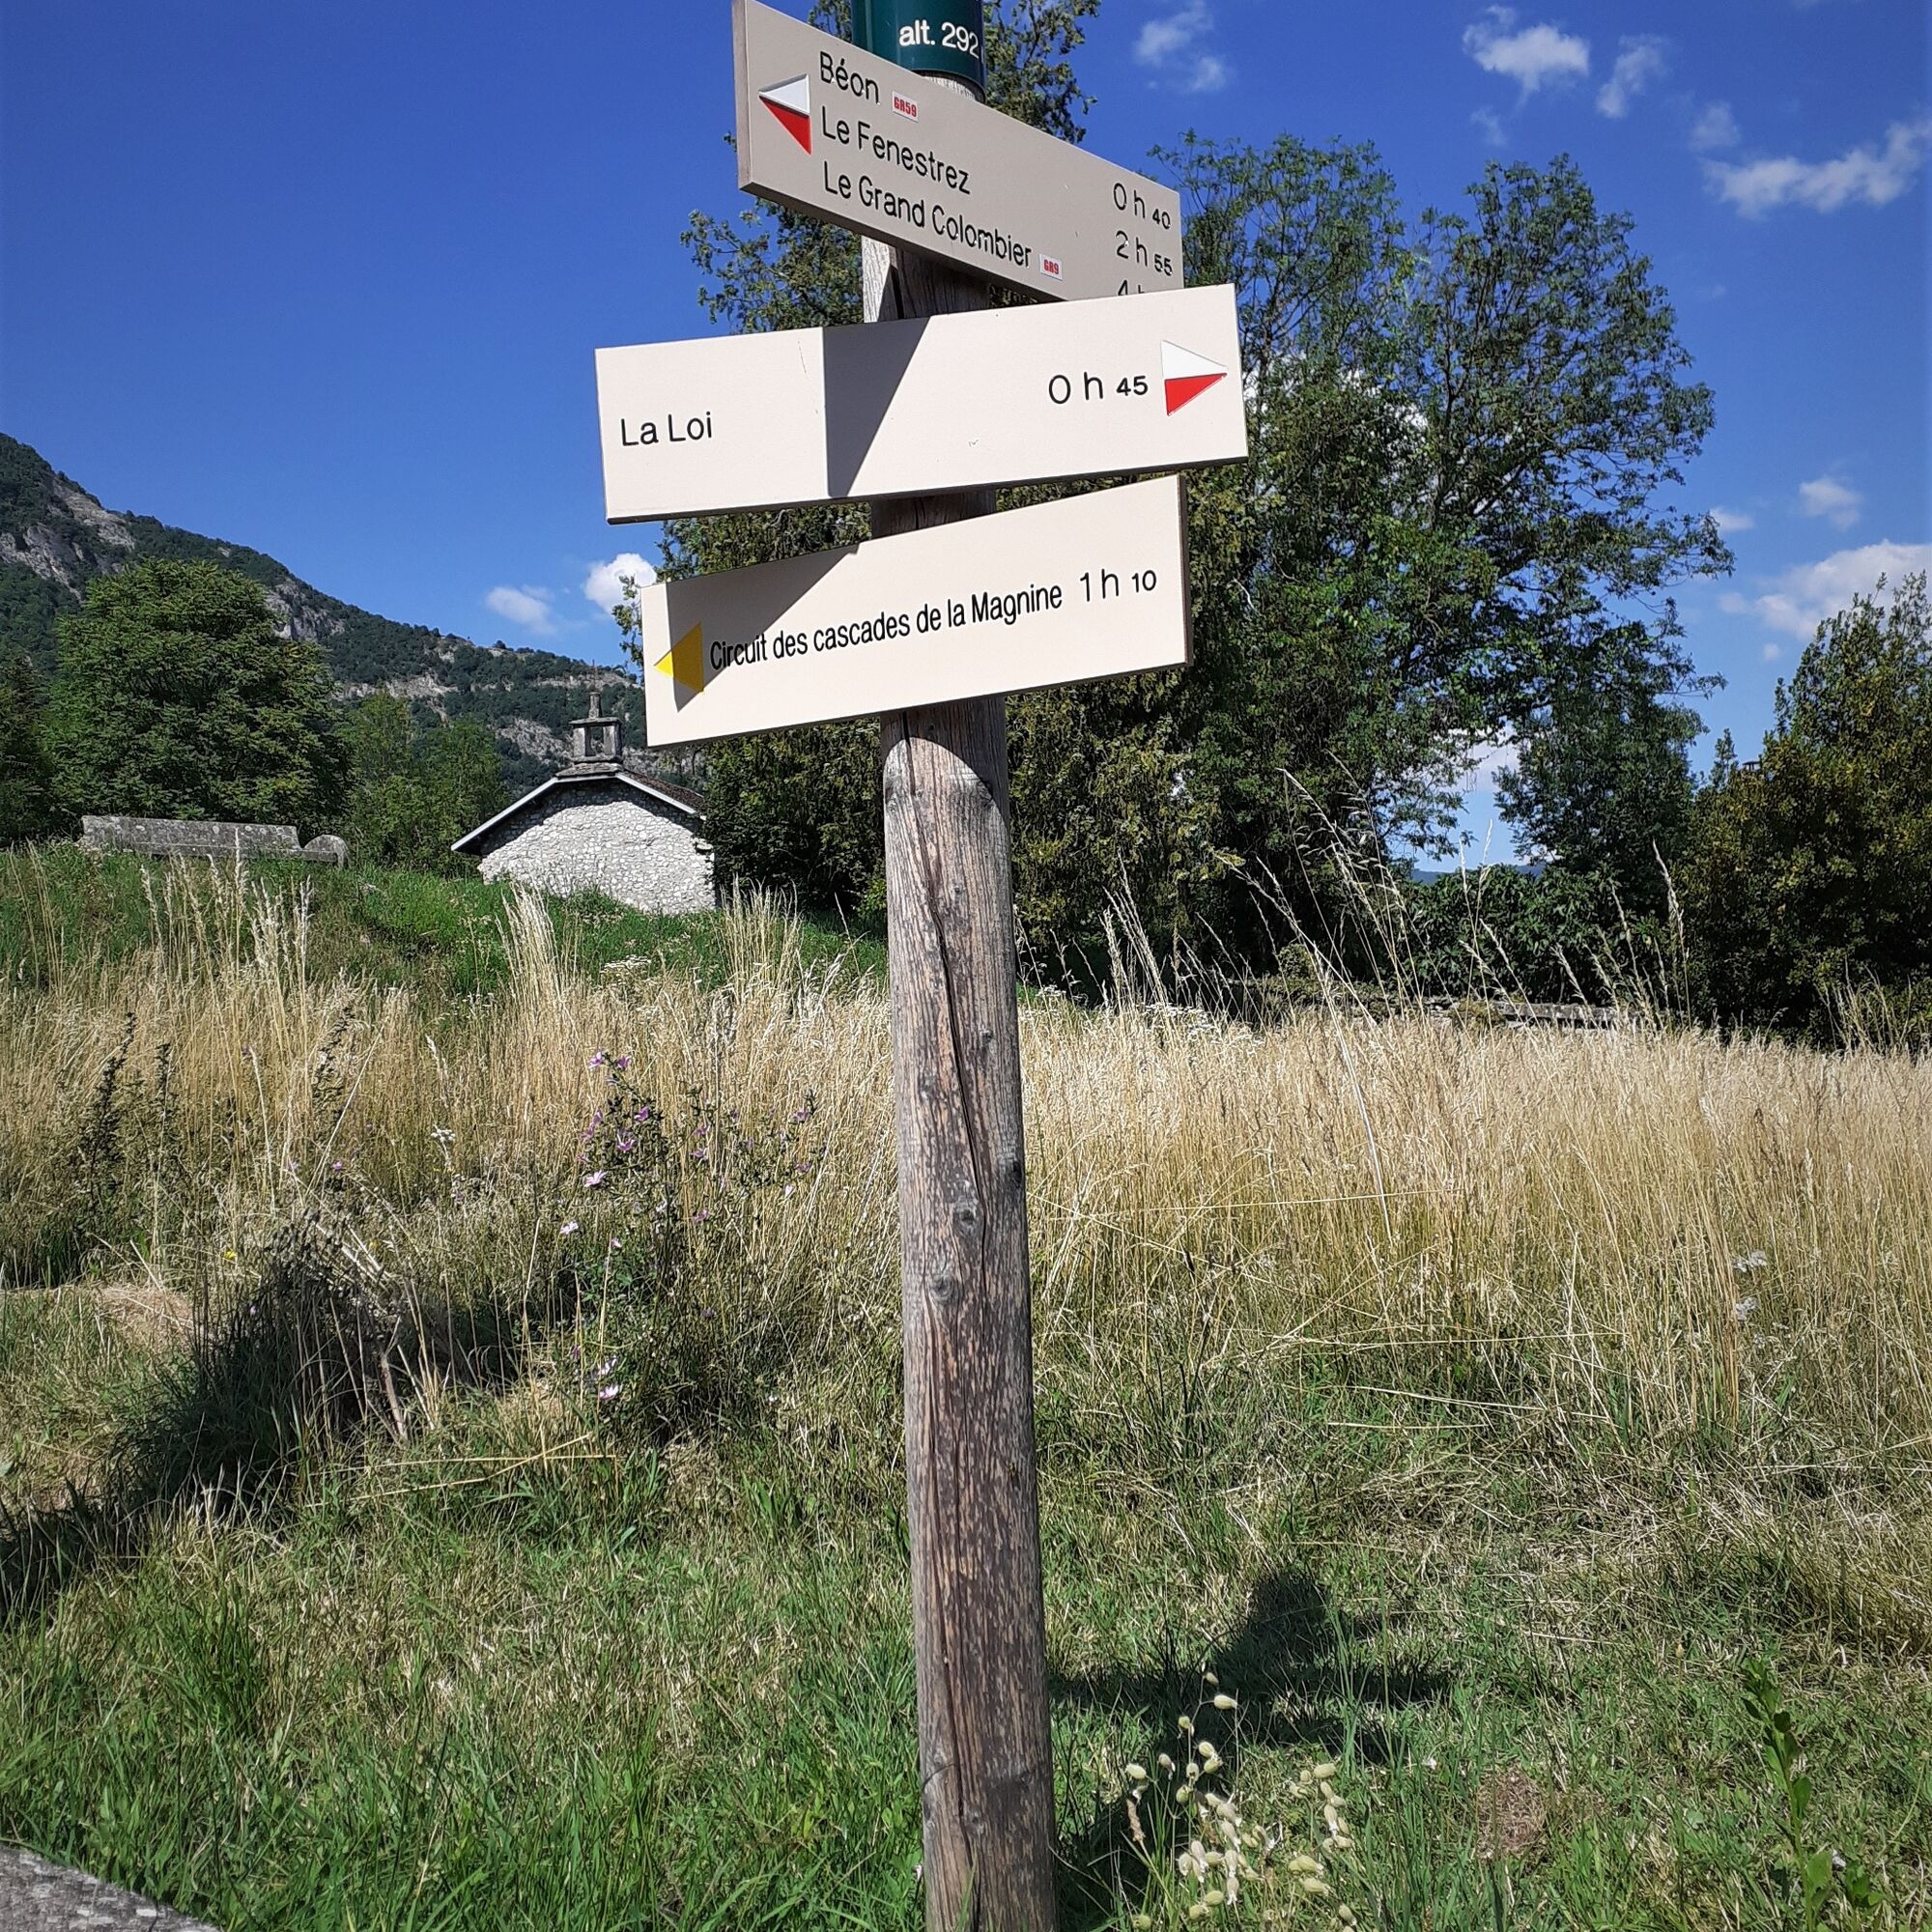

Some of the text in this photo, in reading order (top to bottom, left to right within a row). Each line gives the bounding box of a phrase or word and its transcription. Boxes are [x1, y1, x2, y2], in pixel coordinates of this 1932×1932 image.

[898, 18, 980, 59] alt. 292
[819, 50, 918, 117] Béon GR59
[821, 105, 971, 195] Le Fenestrez
[824, 160, 1060, 274] Le Grand Colombier GR9
[1133, 189, 1146, 219] h
[1151, 208, 1172, 230] 40
[1115, 230, 1173, 277] 2 h 55
[1048, 371, 1149, 405] 0 h 45
[620, 411, 713, 446] La Loi
[709, 631, 767, 671] Circuit
[773, 630, 809, 659] des
[813, 611, 911, 652] cascades
[916, 604, 943, 634] de
[948, 599, 966, 628] la
[971, 585, 1063, 625] Magnine
[1101, 569, 1120, 599] h
[1131, 570, 1157, 593] 10
